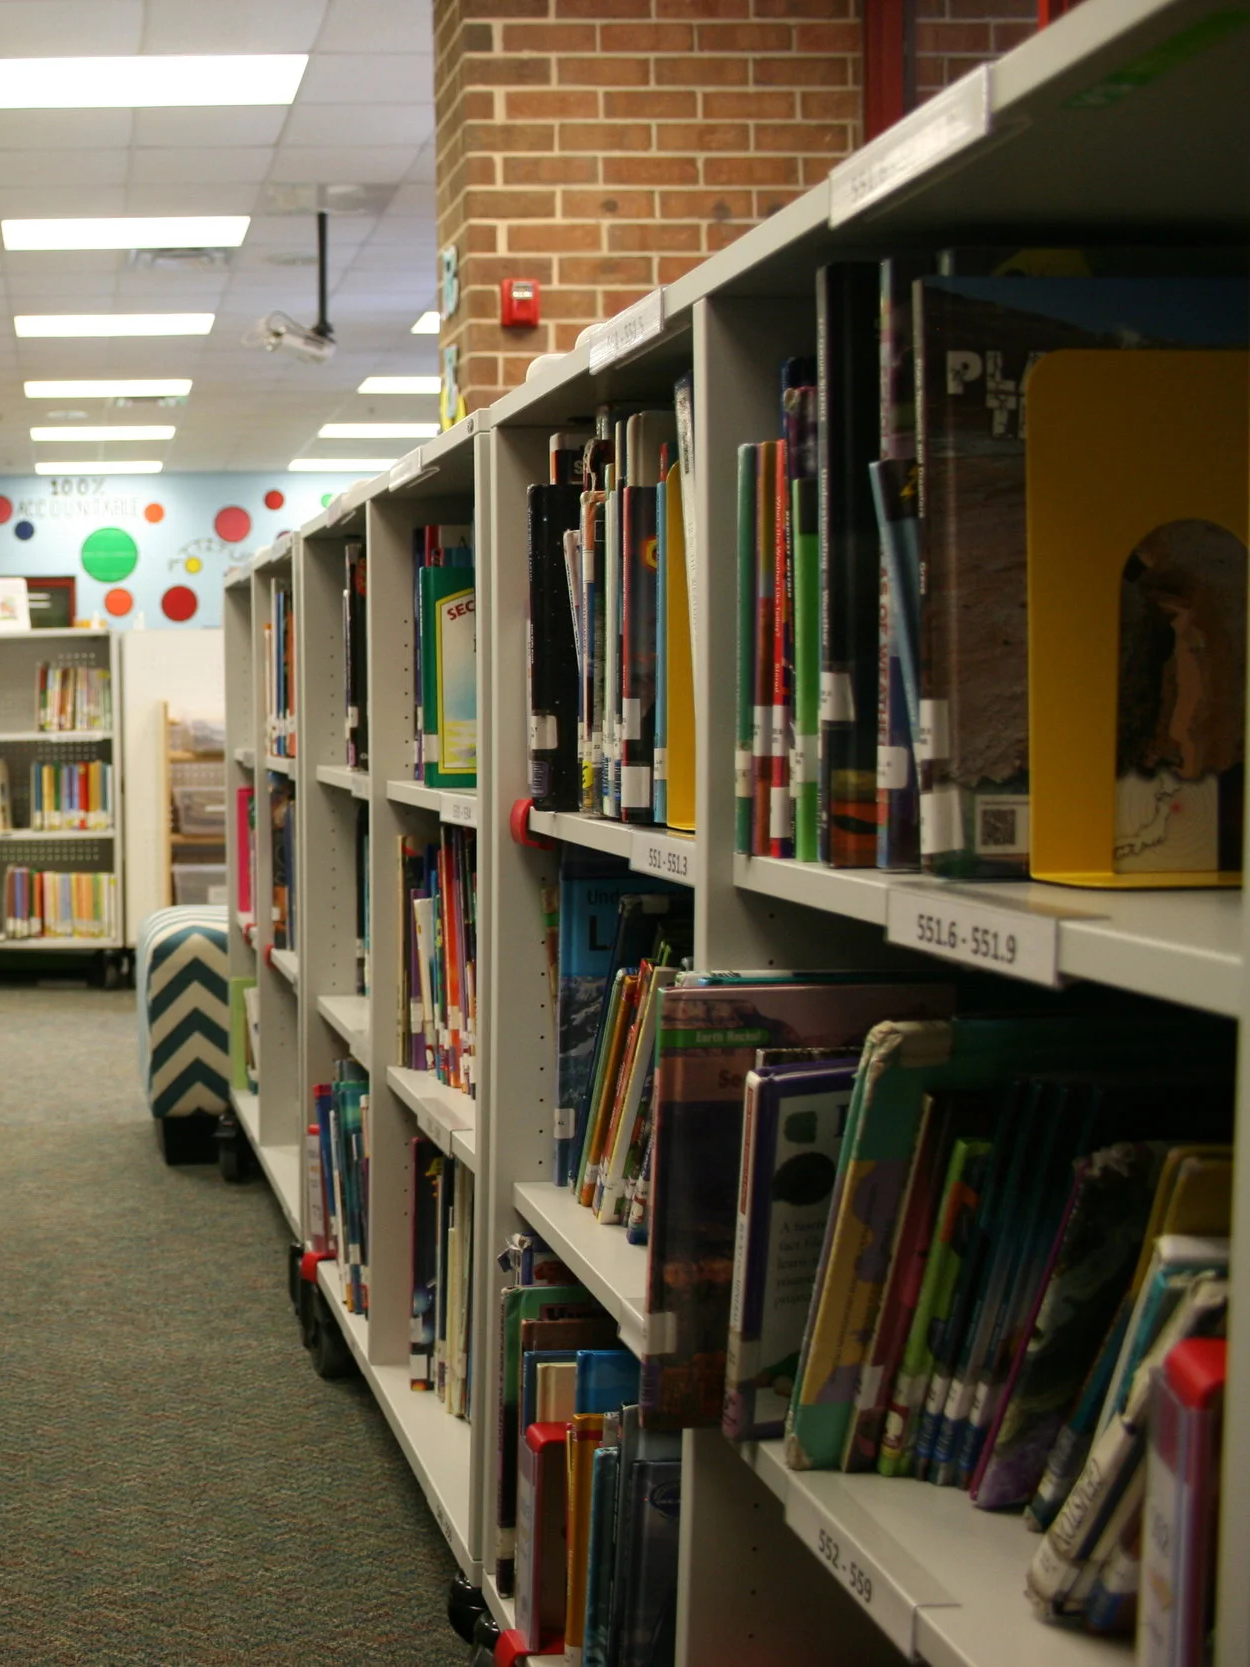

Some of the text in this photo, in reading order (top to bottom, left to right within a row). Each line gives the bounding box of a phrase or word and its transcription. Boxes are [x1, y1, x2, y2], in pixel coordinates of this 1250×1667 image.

[50, 477, 105, 496] 100%
[774, 546, 782, 585] Weather
[820, 468, 830, 646] Understanding Weather
[649, 847, 662, 870] 551
[667, 851, 689, 876] 551.3
[916, 913, 959, 950] 551.6
[969, 925, 1018, 965] 551.9
[695, 1030, 724, 1044] Earth
[818, 1528, 840, 1570] 552
[850, 1561, 872, 1604] 559
